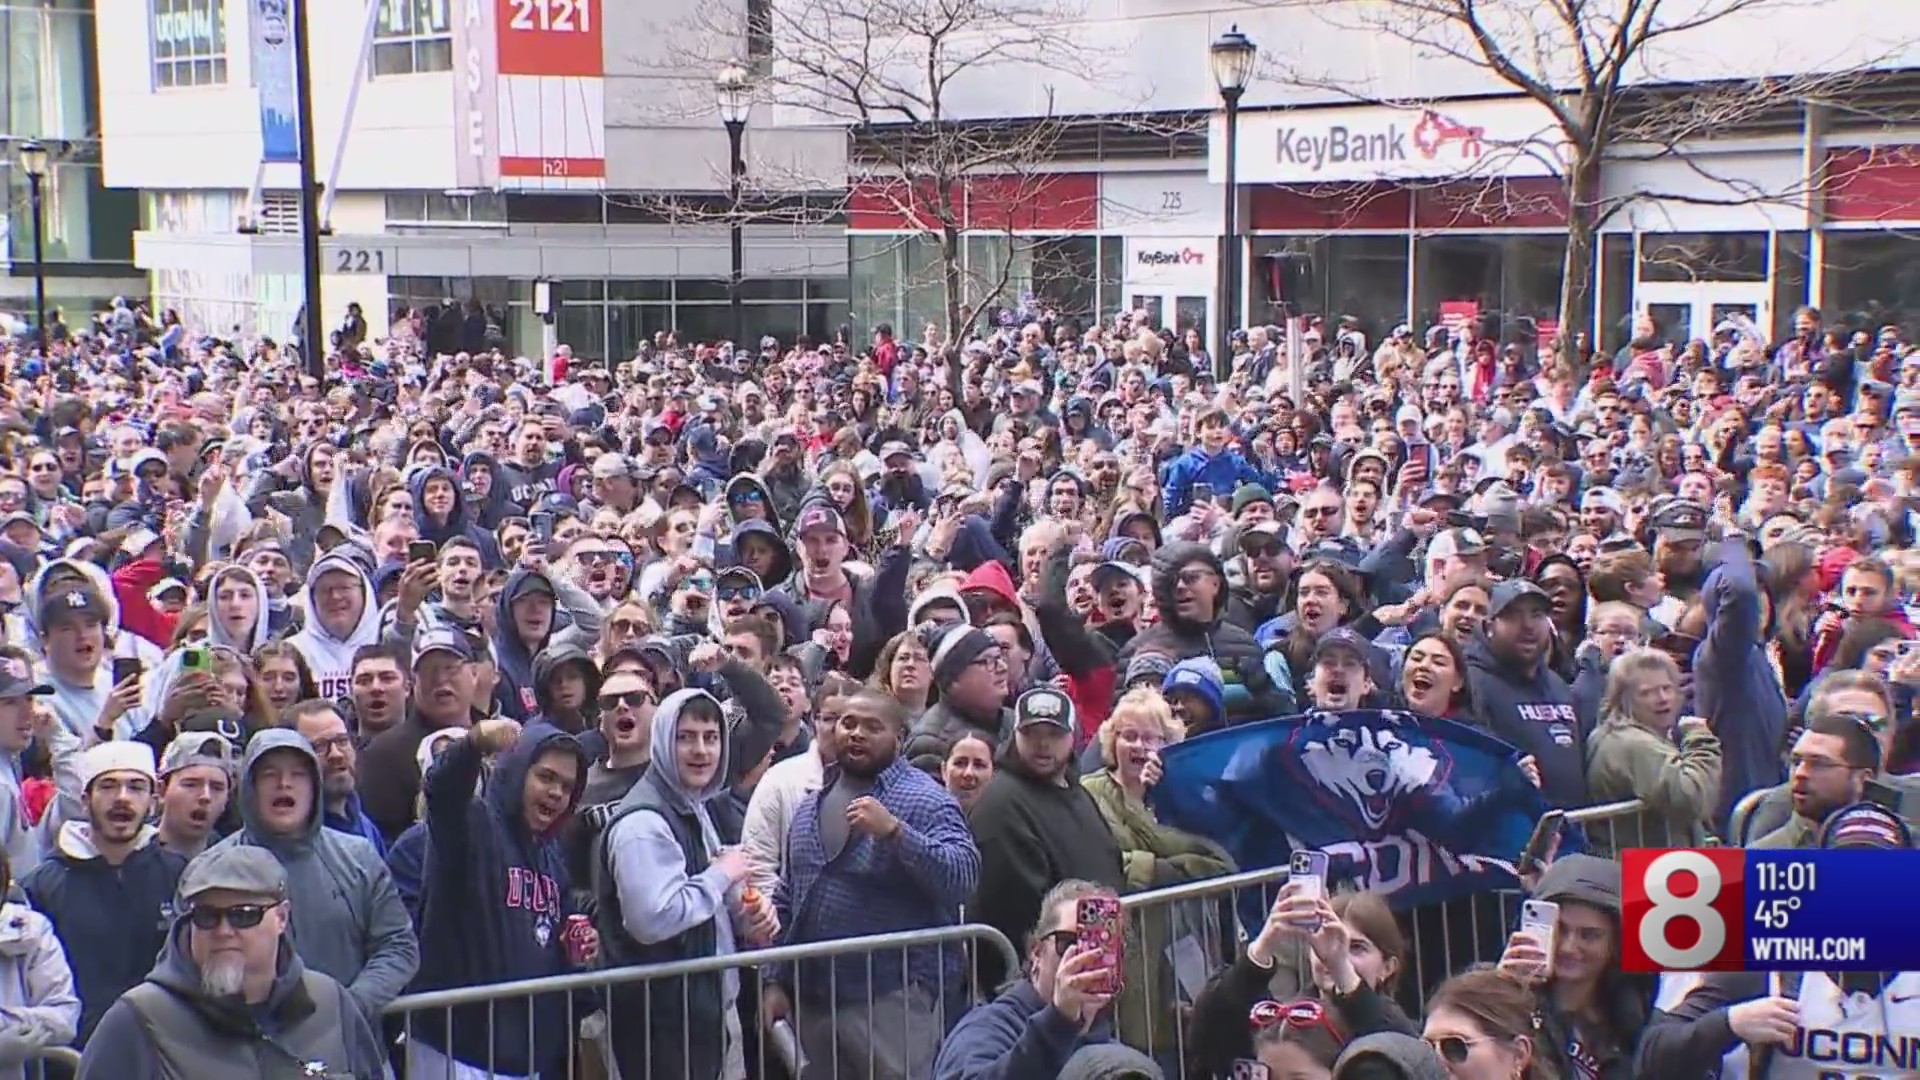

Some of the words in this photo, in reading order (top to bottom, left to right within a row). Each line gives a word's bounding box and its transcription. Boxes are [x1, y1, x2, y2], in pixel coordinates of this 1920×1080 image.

[508, 0, 588, 32] 2121
[1276, 123, 1406, 171] KeyBank
[1162, 191, 1182, 209] 225
[337, 250, 383, 272] 221
[1138, 250, 1181, 266] KeyBank
